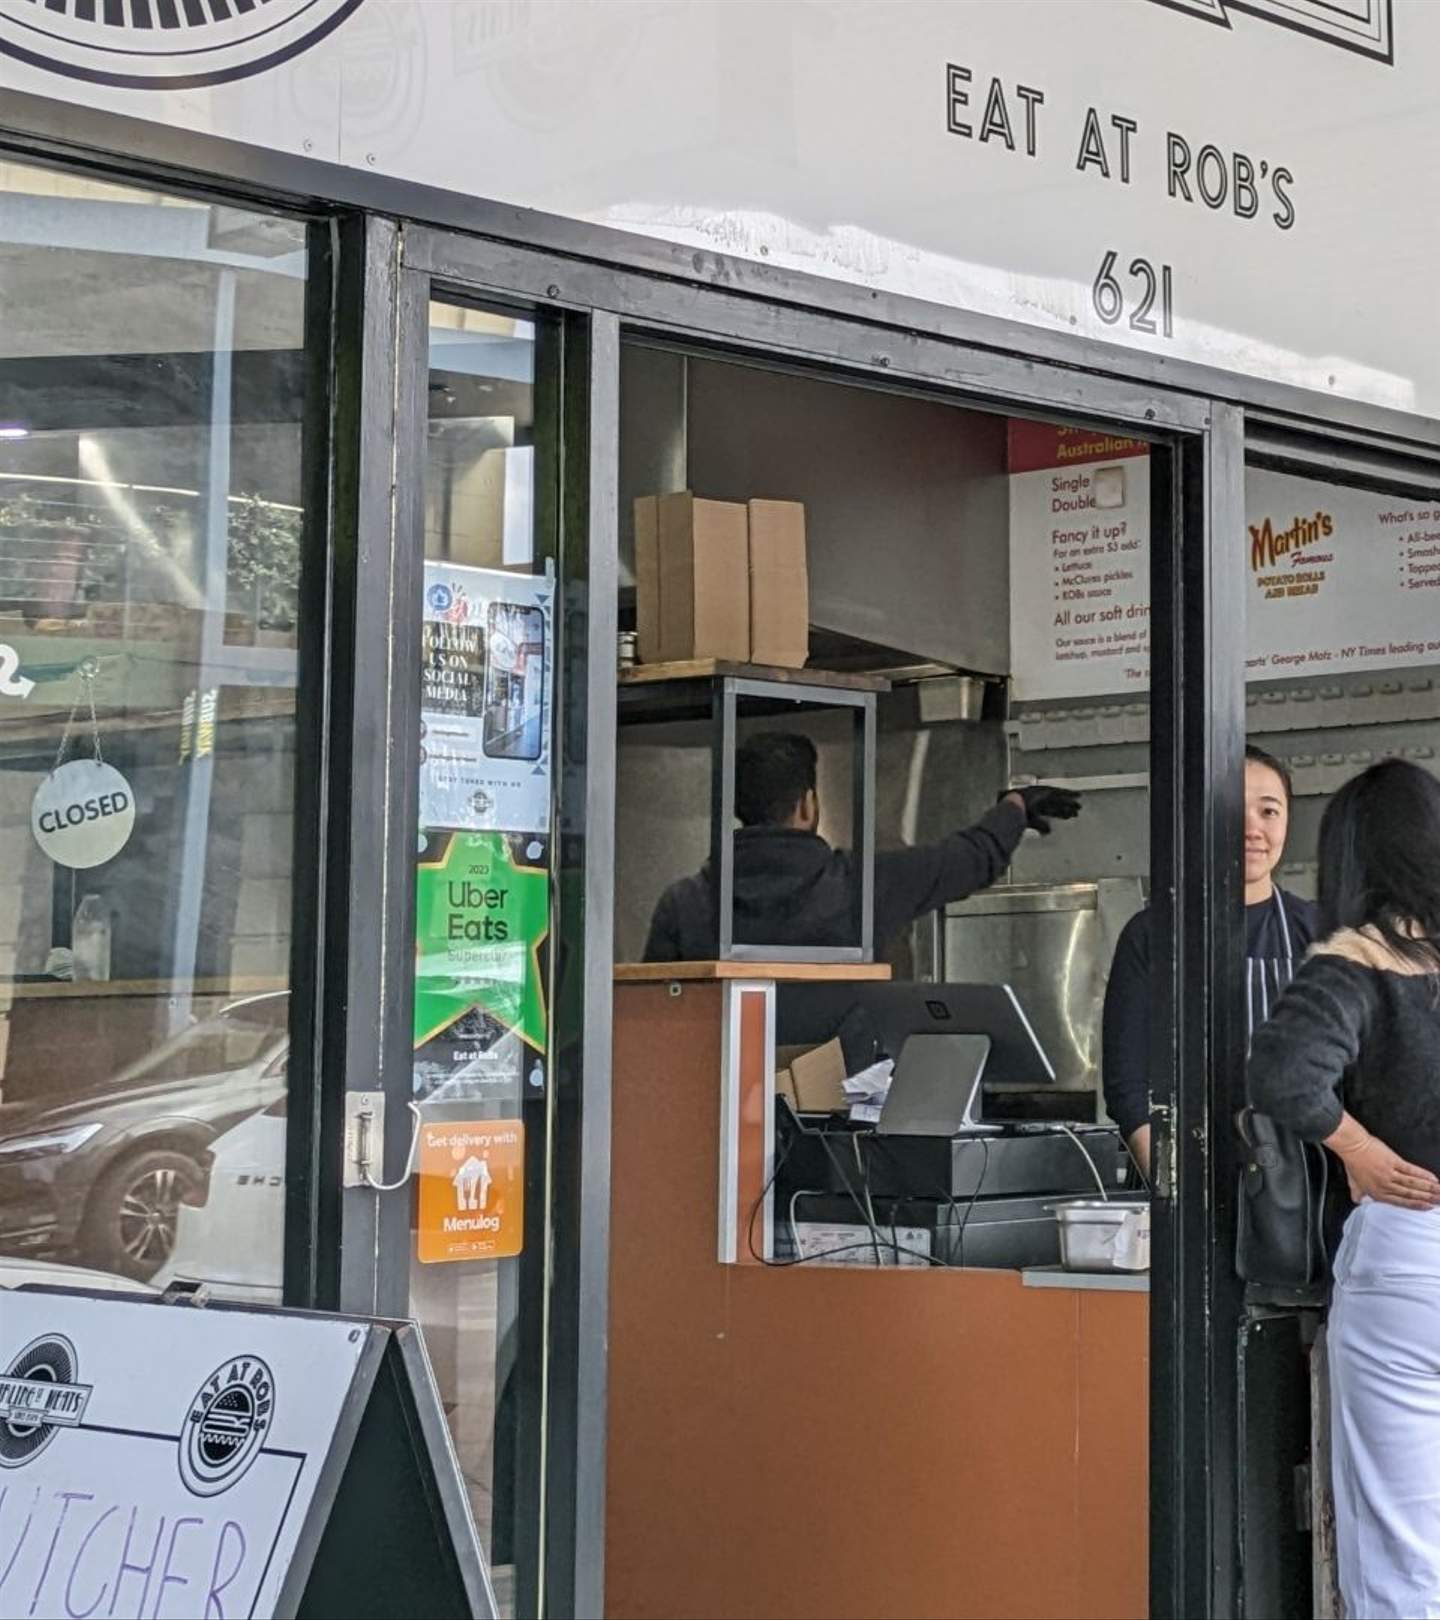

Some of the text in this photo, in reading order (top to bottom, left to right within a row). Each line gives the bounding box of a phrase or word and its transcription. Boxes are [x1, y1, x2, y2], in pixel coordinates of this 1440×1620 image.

[946, 62, 1296, 230] EAT AT ROB'S
[1093, 250, 1173, 338] 621
[1057, 435, 1133, 459] Australian
[1052, 474, 1090, 492] Single
[1052, 495, 1096, 513] Double
[1378, 511, 1414, 523] What's
[1418, 511, 1430, 520] so
[1052, 521, 1127, 544] Fancy it up?
[1248, 511, 1333, 572] Martin's
[1408, 577, 1440, 588] Served
[1054, 609, 1071, 626] All
[1075, 611, 1096, 624] our
[1099, 604, 1122, 621] soft
[1271, 654, 1306, 666] George
[1309, 650, 1332, 661] Motz
[1341, 647, 1356, 658] NY
[1359, 645, 1386, 656] Times
[1389, 642, 1424, 654] leading
[424, 668, 471, 686] SOCIAL
[425, 685, 468, 701] MEDIA
[38, 791, 129, 833] CLOSED
[448, 881, 509, 909] Uber
[448, 914, 509, 941] Eats
[427, 1131, 517, 1148] Get delivery with
[443, 1214, 500, 1233] Menulog
